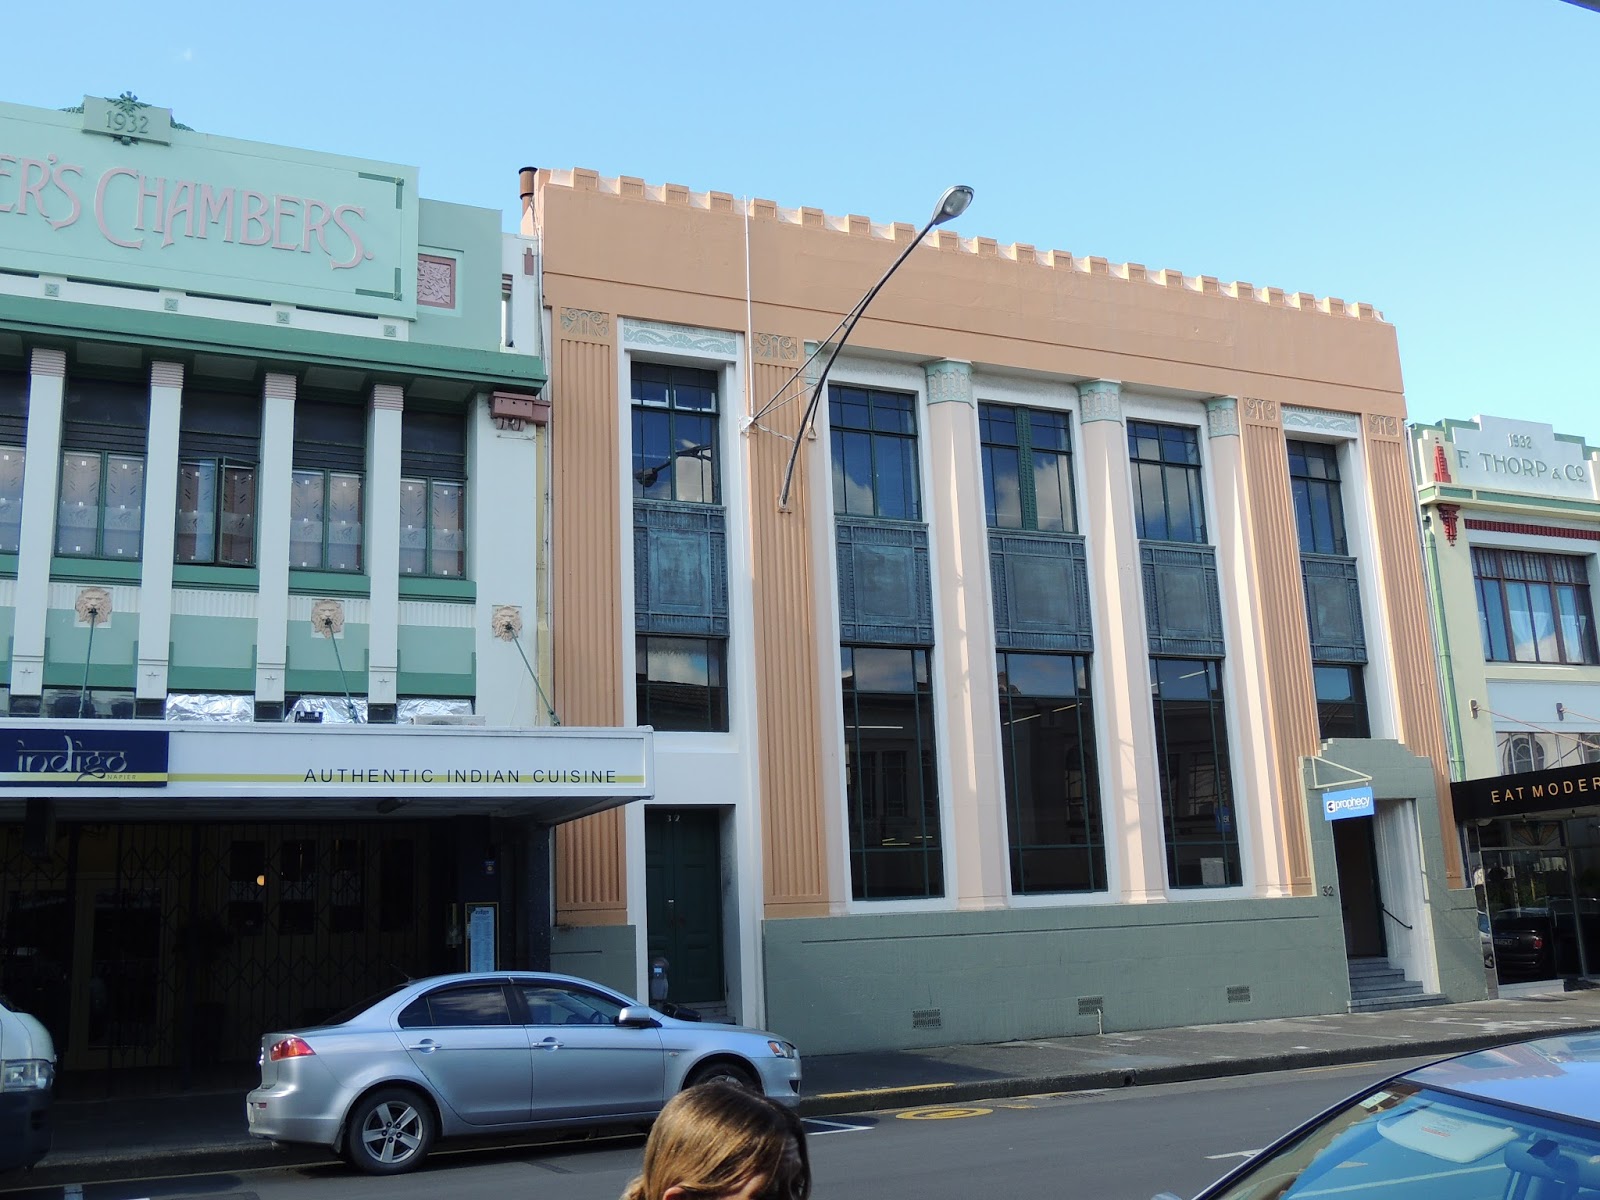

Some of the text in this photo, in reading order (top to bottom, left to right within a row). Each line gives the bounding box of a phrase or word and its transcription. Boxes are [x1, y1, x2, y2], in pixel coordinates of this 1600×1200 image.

[106, 110, 149, 134] 1932
[1508, 433, 1533, 449] 1932
[1478, 452, 1548, 478] THORP
[1551, 467, 1562, 480] &
[16, 735, 127, 781] indigo
[304, 768, 617, 784] AUTHENTIC INDIAN CUISINE
[1490, 776, 1600, 803] EAT MODER
[1335, 796, 1370, 811] prophecy
[1322, 886, 1334, 897] 32
